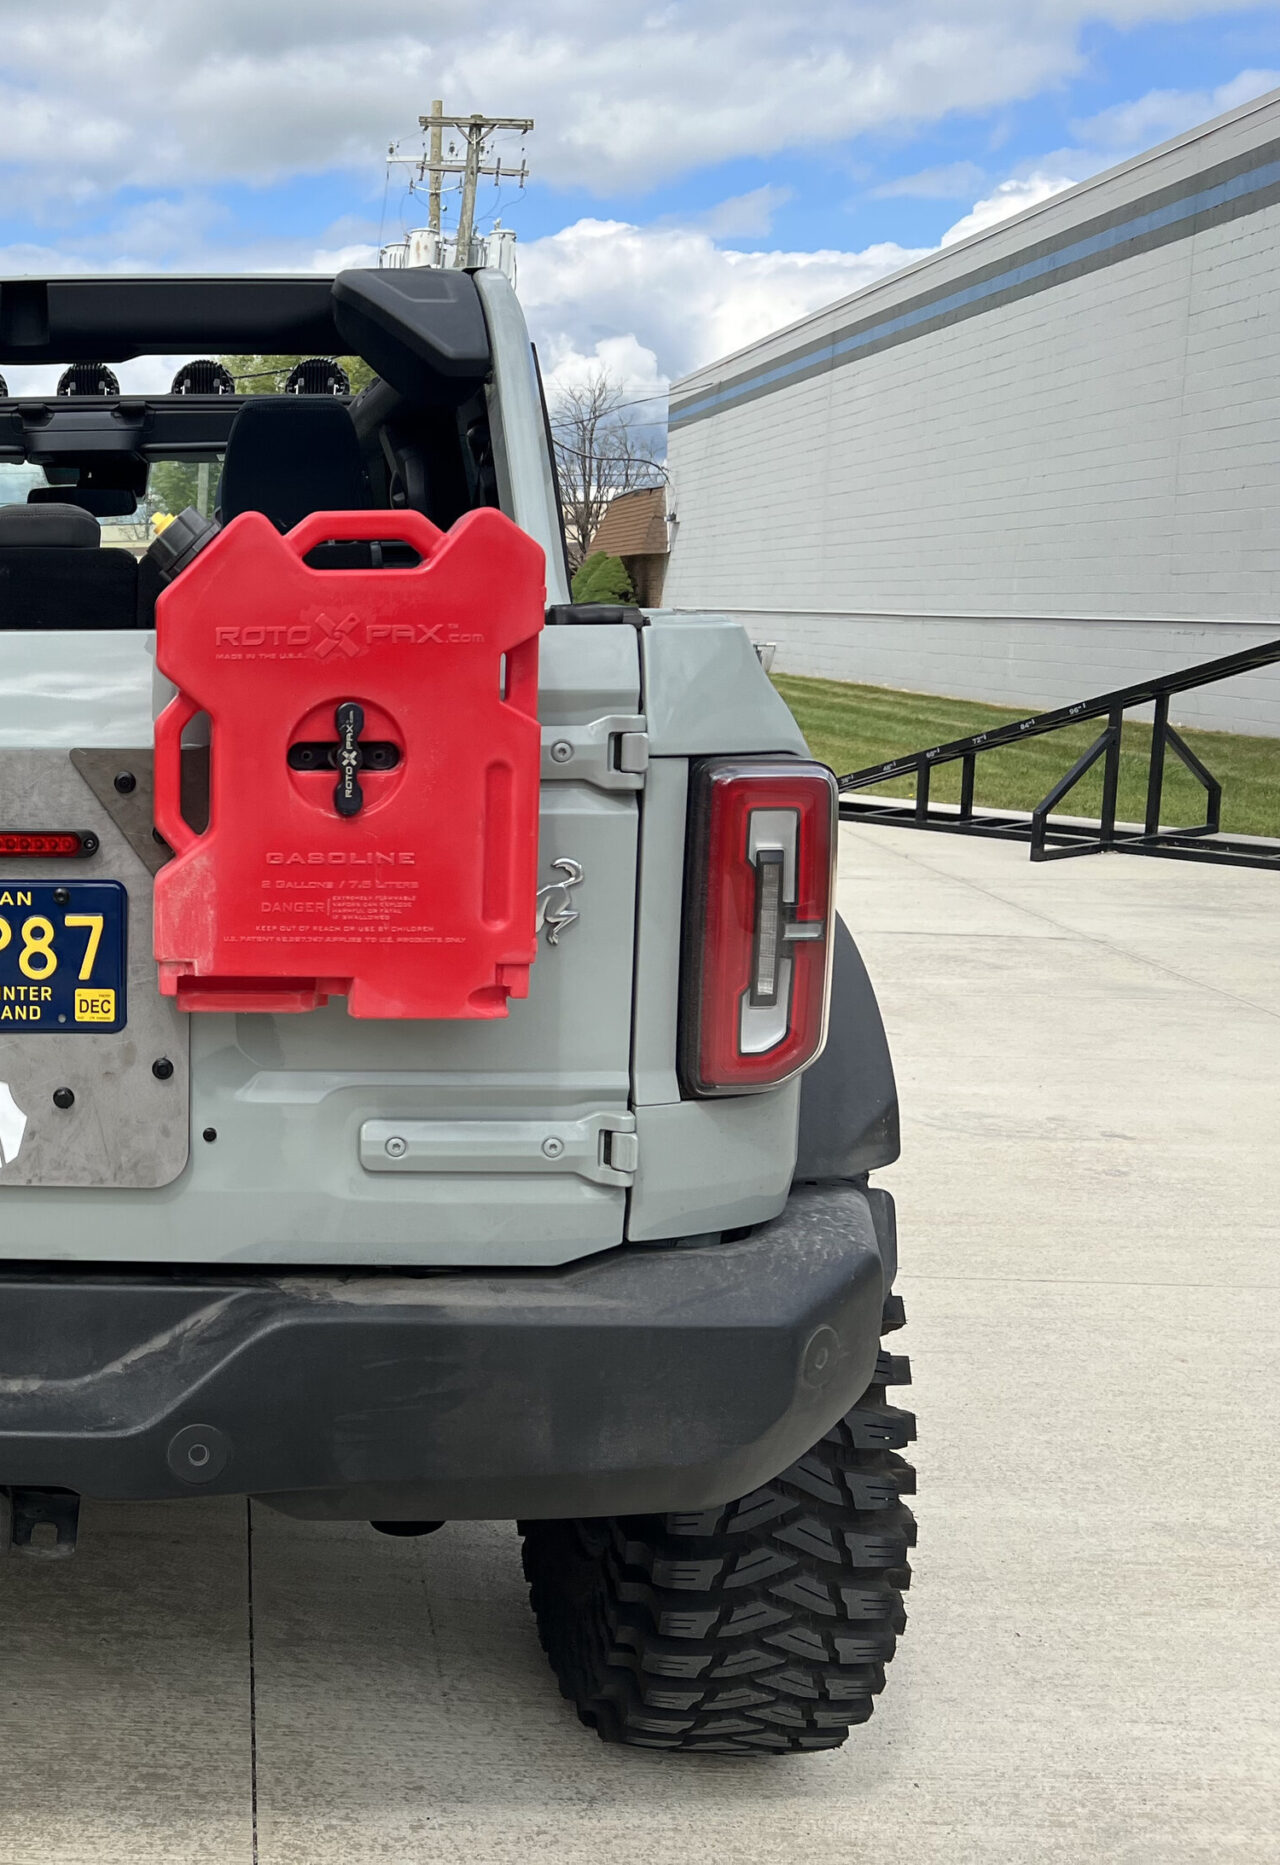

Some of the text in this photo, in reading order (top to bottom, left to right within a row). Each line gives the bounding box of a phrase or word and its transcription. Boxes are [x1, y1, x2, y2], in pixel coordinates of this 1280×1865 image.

[216, 626, 312, 646] ROTO
[345, 766, 353, 798] ROTO
[266, 852, 416, 865] GASOLINE
[261, 902, 325, 913] DANGER
[79, 999, 111, 1014] DEC
